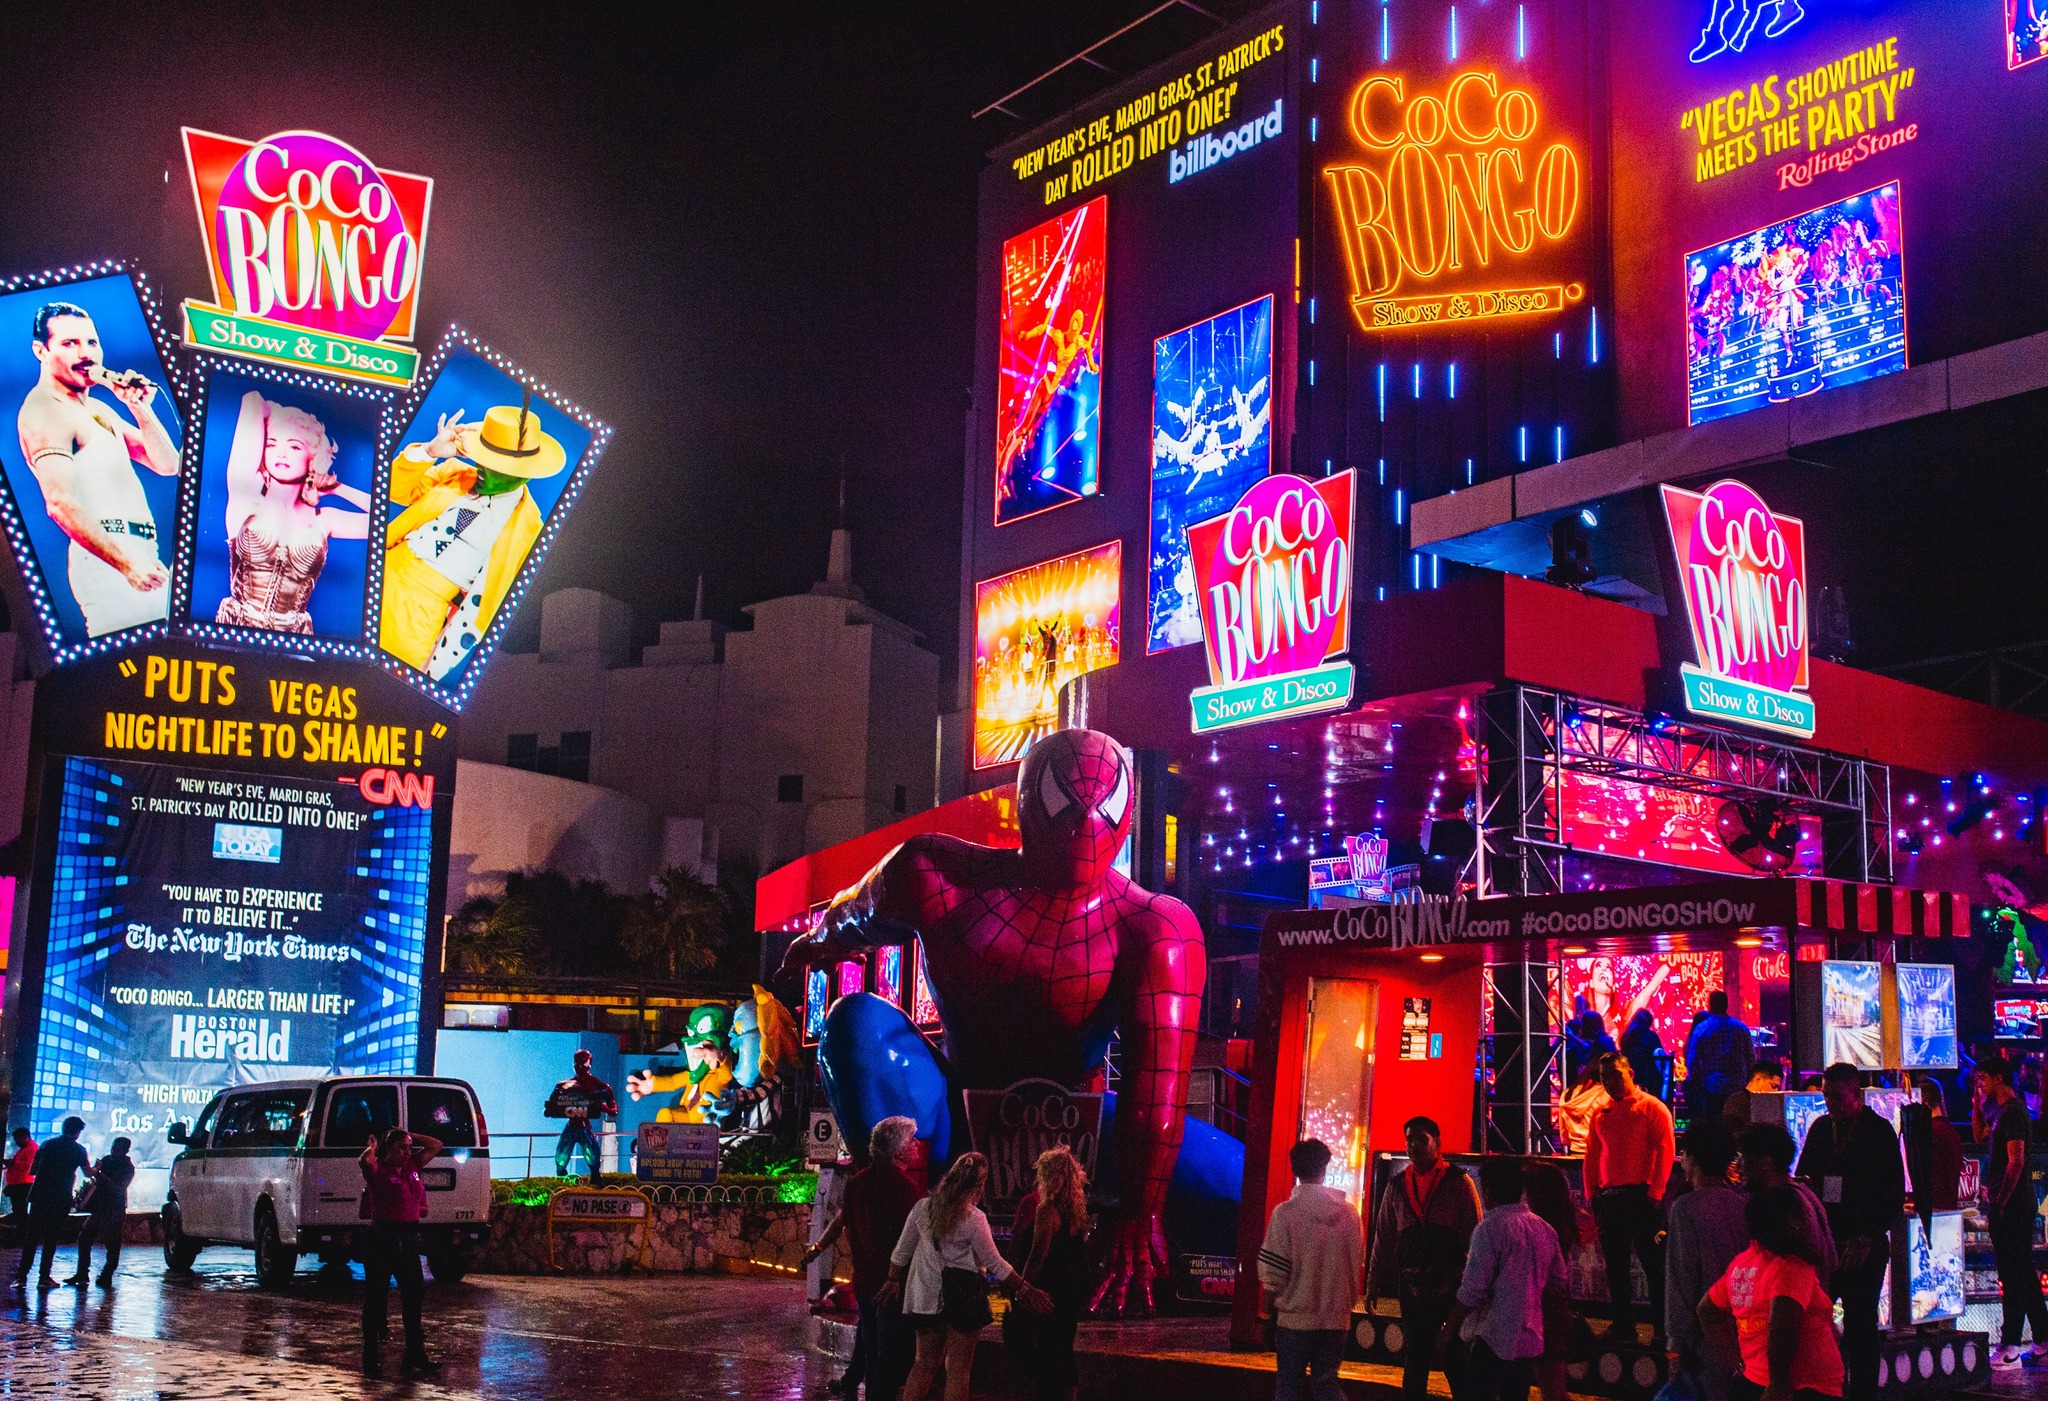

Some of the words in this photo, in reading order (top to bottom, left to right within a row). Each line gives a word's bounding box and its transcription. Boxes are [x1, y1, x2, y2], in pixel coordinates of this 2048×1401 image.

[1088, 114, 1113, 144] EVE,
[1115, 91, 1156, 133] MARDI
[1158, 72, 1196, 110] GRAS,
[1196, 62, 1216, 92] ST.
[1217, 24, 1284, 81] PATRICK'S
[1785, 36, 1899, 111] SHOWTIME
[1045, 172, 1069, 206] DAY
[1071, 133, 1135, 193] ROLLED
[1139, 109, 1182, 161] INTO
[1168, 98, 1284, 185] billboard
[1696, 131, 1758, 183] MEETS
[1761, 113, 1801, 156] THE
[1322, 143, 1579, 303] BONGO
[218, 201, 418, 318] BONGO
[1373, 300, 1441, 327] Show
[1446, 294, 1472, 319] &
[1475, 291, 1549, 314] Disco
[209, 318, 288, 353] Show
[293, 336, 318, 360] &
[324, 340, 399, 374] Disco
[1208, 536, 1349, 686] BONGO
[1689, 554, 1806, 676] BONGO
[269, 679, 358, 721] VEGAS
[1206, 697, 1257, 723] Show
[1260, 686, 1279, 710] &
[1282, 678, 1337, 705] Disco
[1698, 681, 1744, 712] Show
[1745, 692, 1760, 715] &
[1763, 695, 1805, 725] Disco
[105, 711, 253, 757] NIGHTLIFE
[259, 722, 296, 759] TO
[131, 797, 146, 812] ST.
[204, 803, 226, 818] DAY
[228, 799, 284, 824] ROLLED
[287, 806, 321, 828] INTO
[245, 785, 266, 802] EVE,
[269, 787, 303, 802] MARDI
[305, 790, 335, 808] GRAS,
[219, 838, 274, 857] TODAY
[239, 826, 271, 843] USA
[1352, 851, 1387, 880] BONGO
[194, 887, 223, 904] HAVE
[225, 889, 240, 905] TO
[242, 886, 324, 912] EXPERIENCE
[182, 908, 194, 923] IT
[196, 908, 211, 925] TO
[213, 906, 267, 929] BELIEVE
[125, 923, 169, 953] The
[169, 927, 222, 955] New
[223, 930, 281, 962] York
[281, 934, 350, 963] Times
[1680, 963, 1699, 983] BAR
[207, 987, 265, 1011] LARGER
[269, 990, 307, 1013] THAN
[170, 1014, 291, 1062] Herald
[198, 1015, 257, 1031] BOSTON
[181, 1087, 220, 1105] VOLTA
[109, 1107, 154, 1134] Los
[819, 1122, 827, 1139] E
[1325, 1172, 1351, 1186] PRA
[455, 1211, 475, 1220] 1717
[572, 1199, 588, 1214] NO
[591, 1200, 618, 1214] PASE
